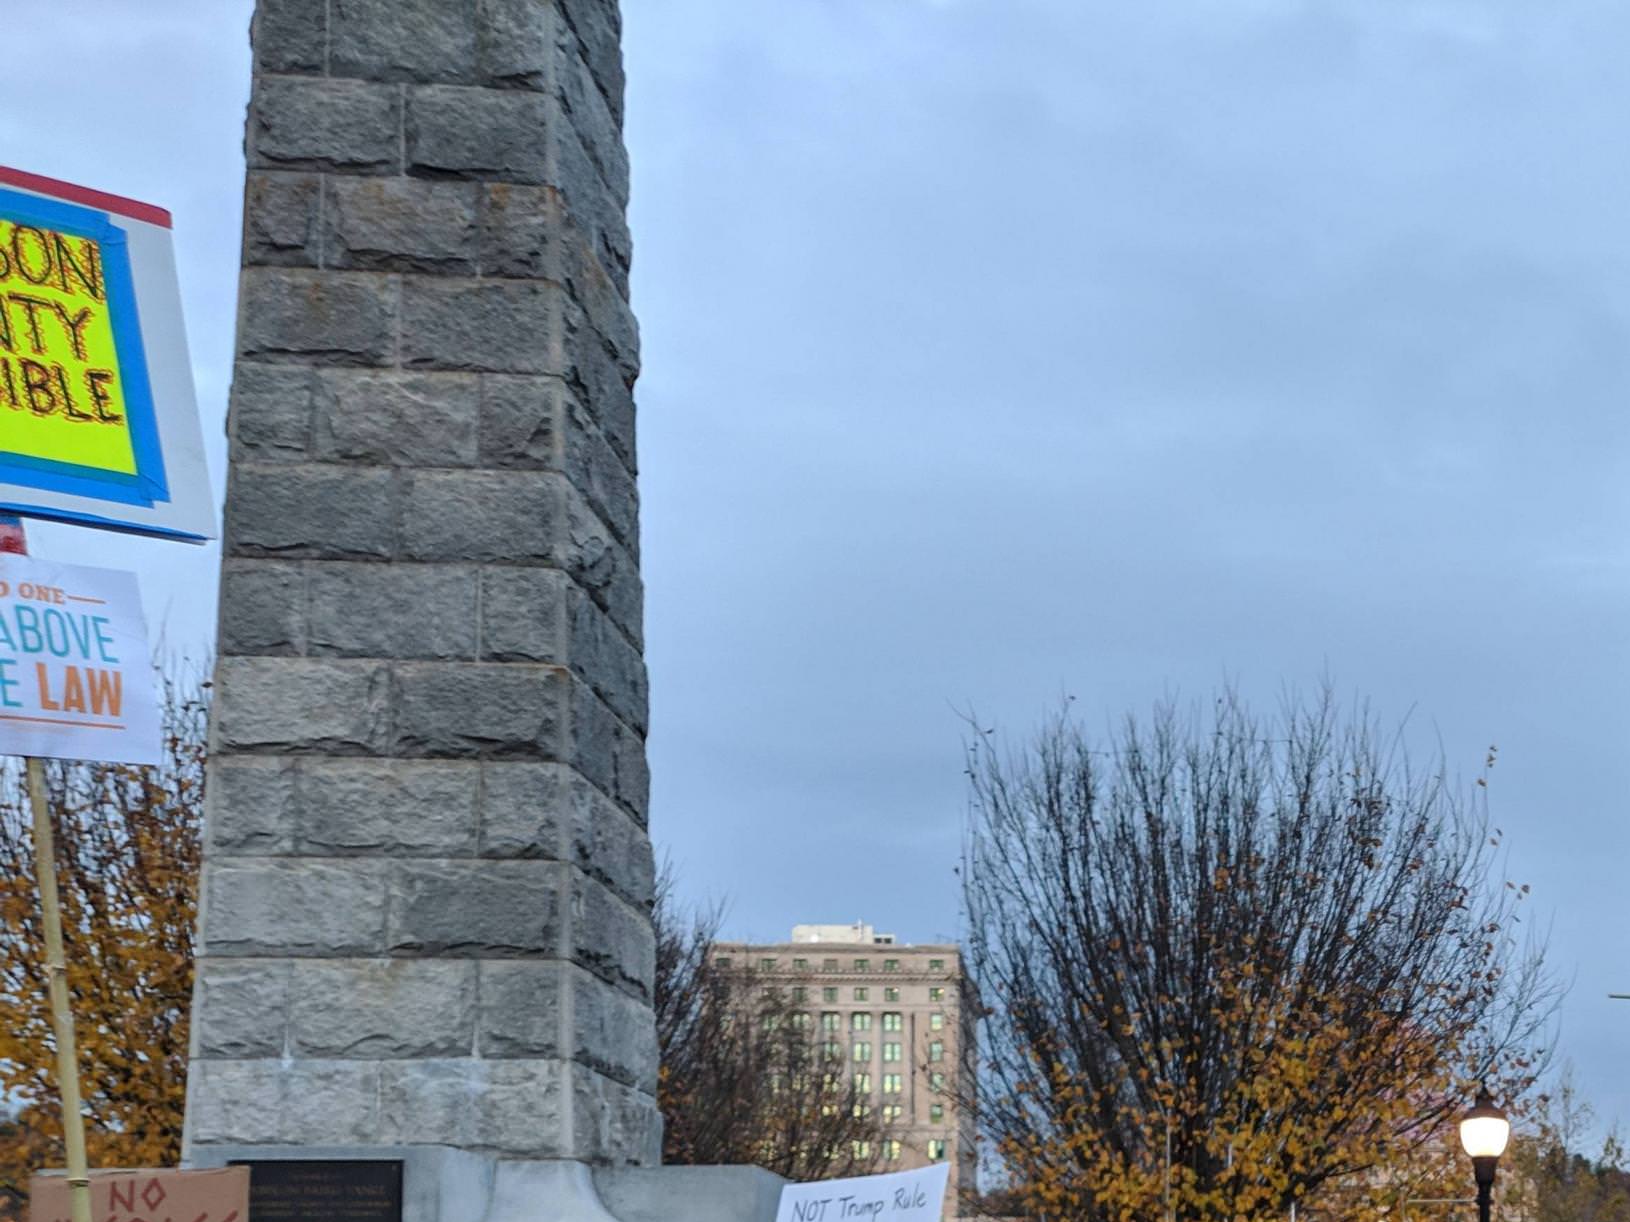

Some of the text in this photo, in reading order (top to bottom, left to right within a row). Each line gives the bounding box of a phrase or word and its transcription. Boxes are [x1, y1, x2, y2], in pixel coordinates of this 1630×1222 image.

[18, 582, 65, 605] ONE
[35, 662, 122, 717] LAW
[109, 1177, 166, 1212] NO
[839, 1195, 884, 1222] Trump
[892, 1183, 926, 1211] Rule
